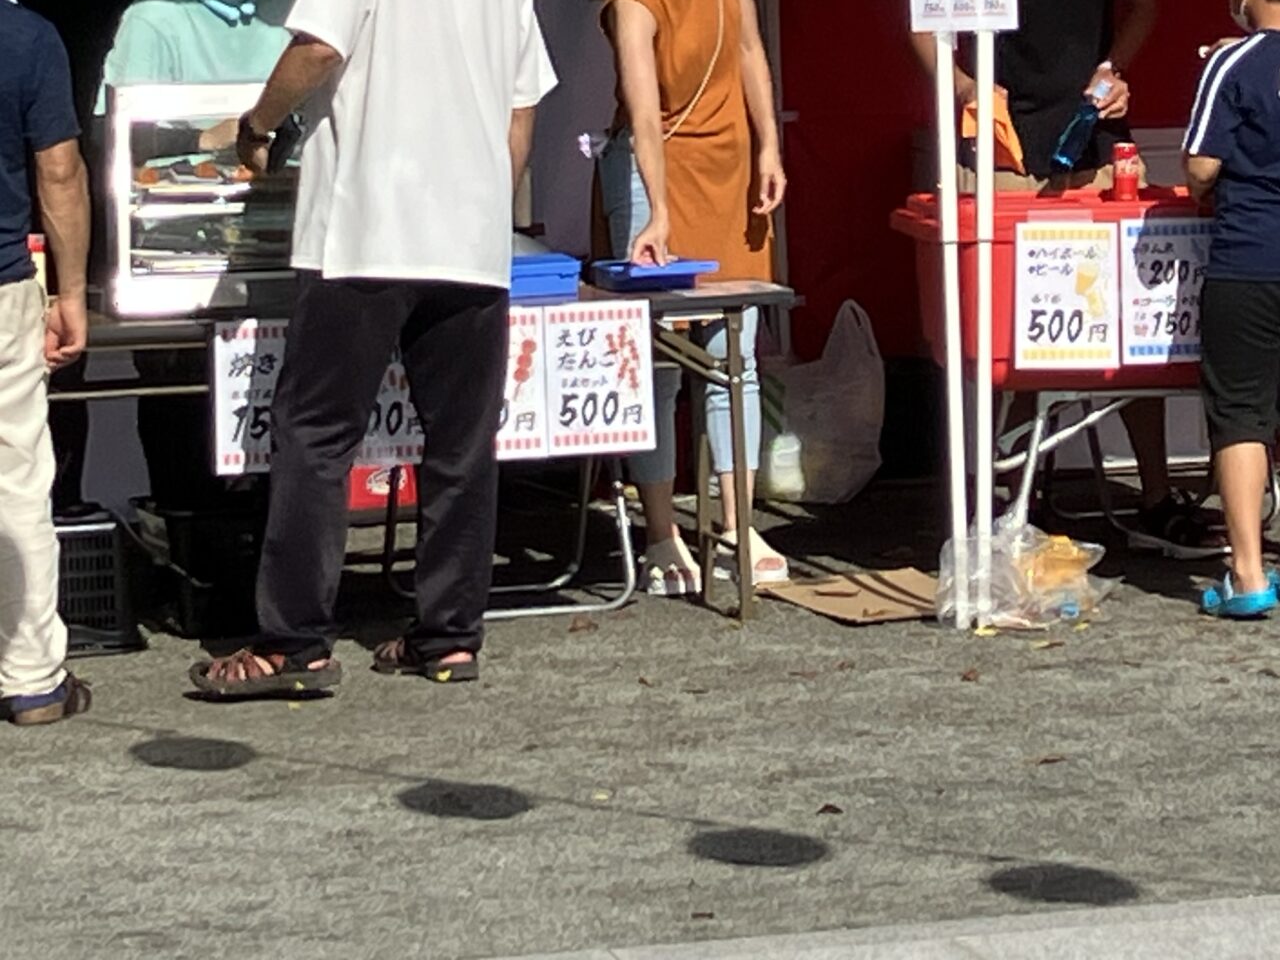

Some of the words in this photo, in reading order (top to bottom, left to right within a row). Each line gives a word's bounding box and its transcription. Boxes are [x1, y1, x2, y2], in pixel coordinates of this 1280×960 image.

[556, 327, 598, 348] えび
[1028, 309, 1108, 343] 500円
[1152, 311, 1200, 337] 150
[560, 391, 642, 428] 500円
